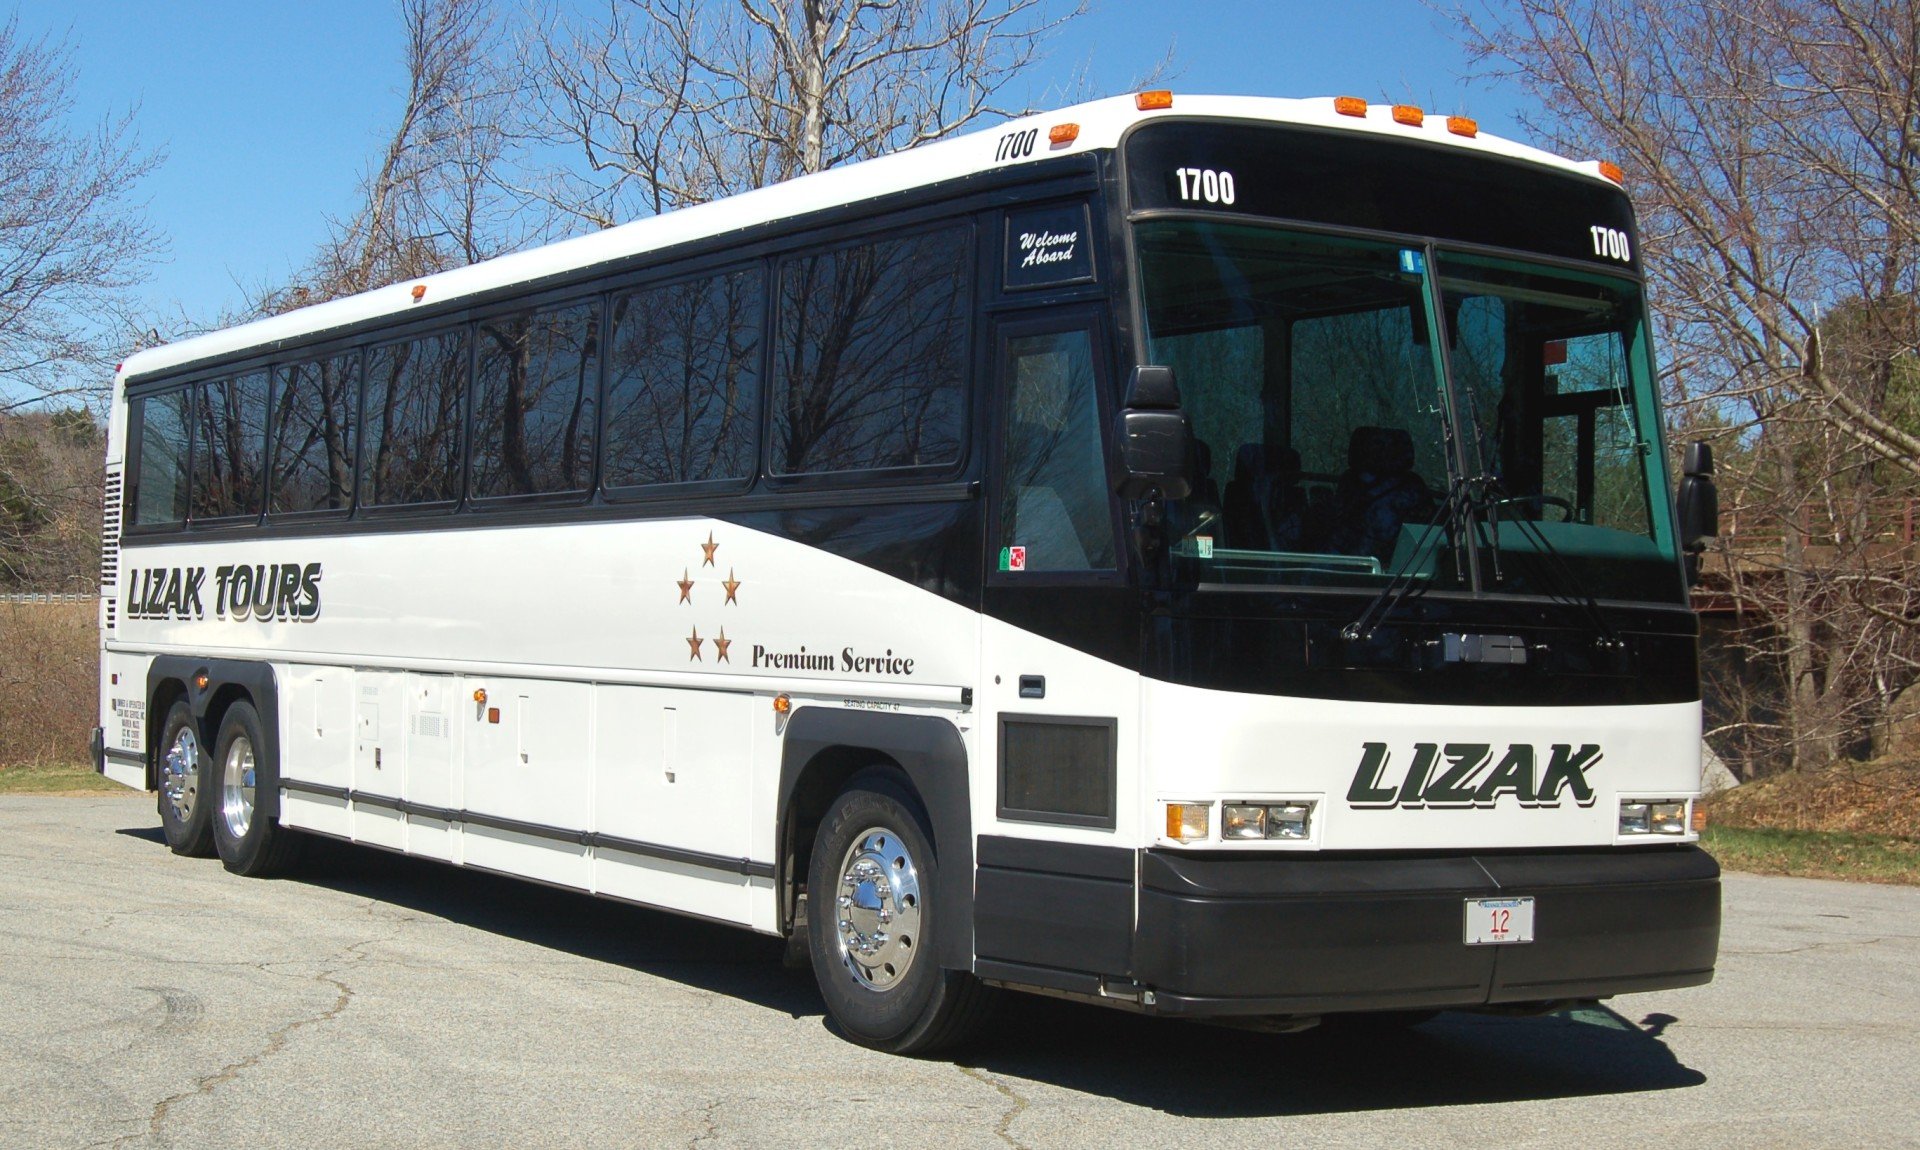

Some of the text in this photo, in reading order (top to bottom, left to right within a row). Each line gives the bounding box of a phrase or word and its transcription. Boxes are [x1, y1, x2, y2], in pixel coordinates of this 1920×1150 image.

[995, 128, 1038, 162] 1700
[1176, 167, 1235, 204] 1700
[1020, 230, 1077, 250] Welcome
[1021, 244, 1074, 268] Aboard
[1590, 226, 1631, 262] 1700
[127, 563, 323, 623] LIZAK TOURS
[752, 645, 915, 675] Premium Service
[1346, 742, 1604, 810] LIZAK
[1491, 910, 1509, 932] 12
